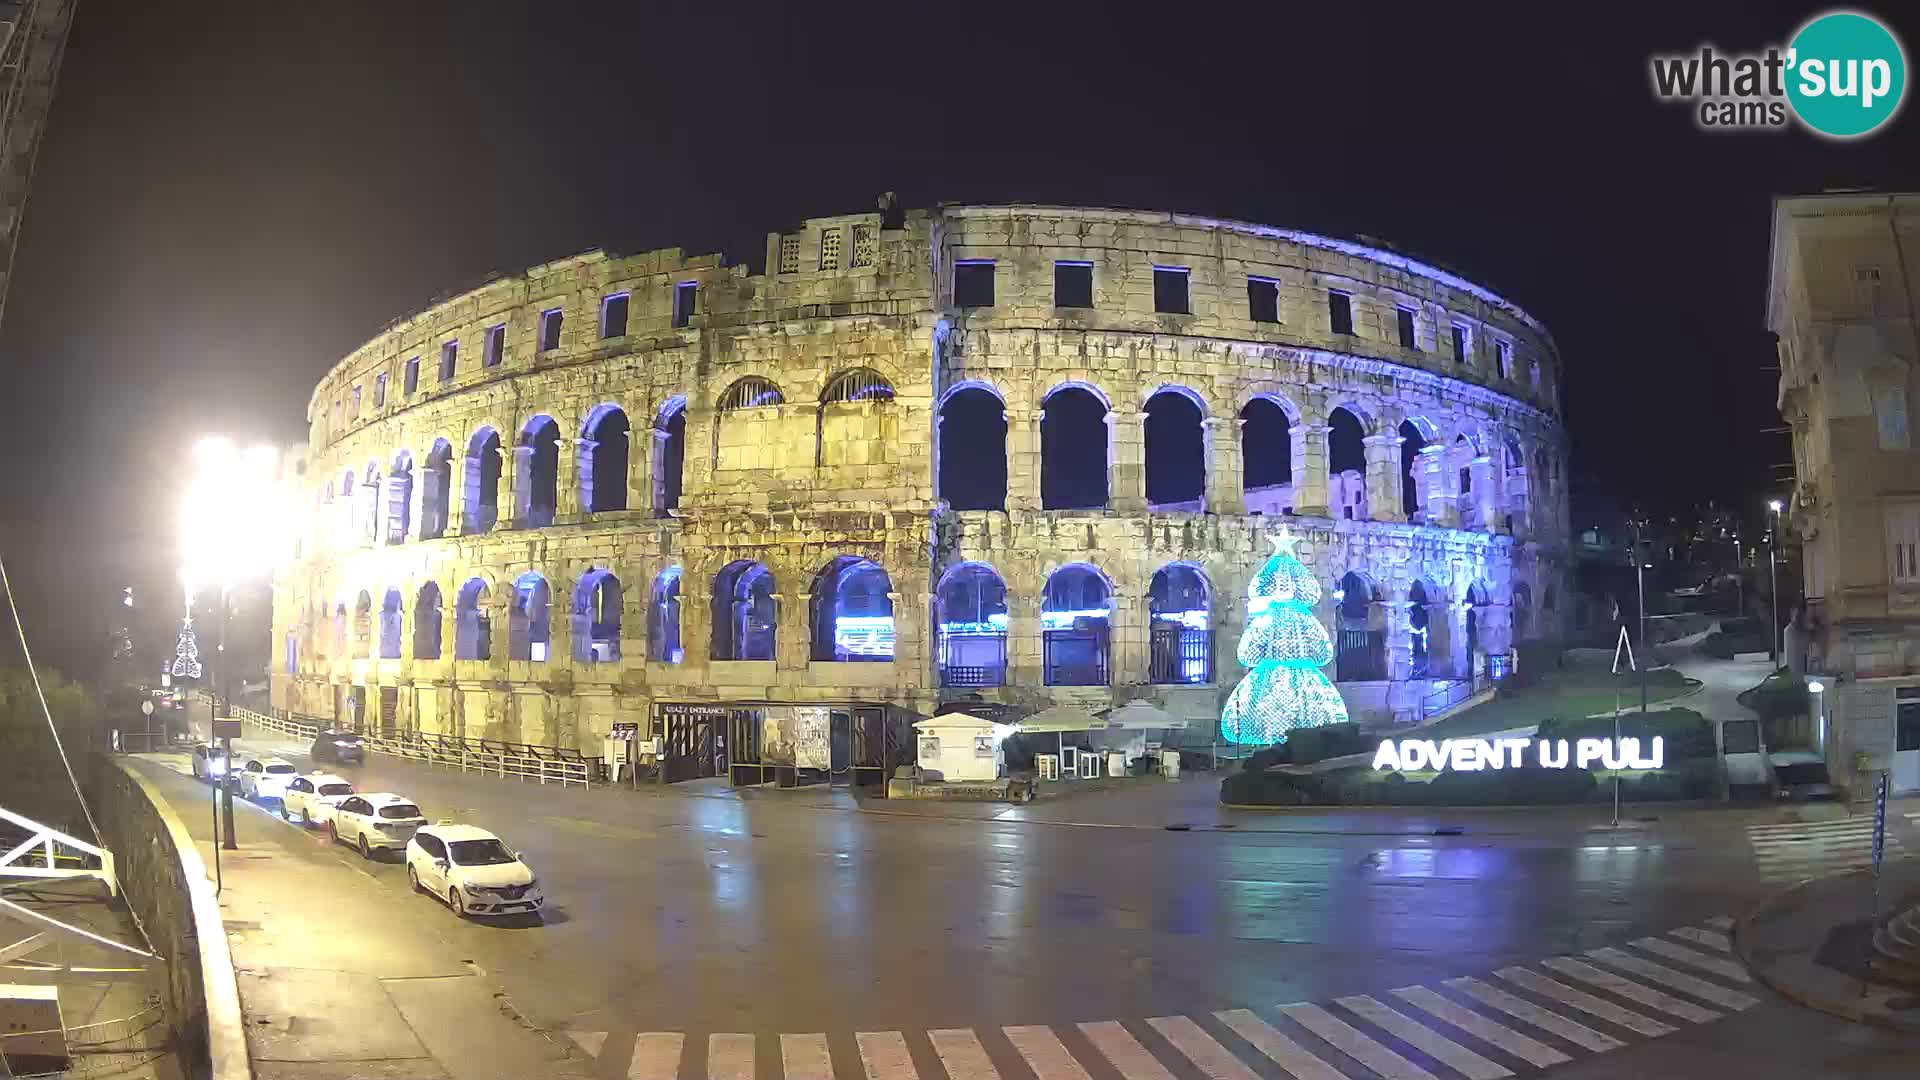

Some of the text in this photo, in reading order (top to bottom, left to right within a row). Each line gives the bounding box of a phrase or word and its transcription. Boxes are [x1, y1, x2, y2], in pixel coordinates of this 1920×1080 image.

[1372, 736, 1664, 771] ADVENT U PULI
